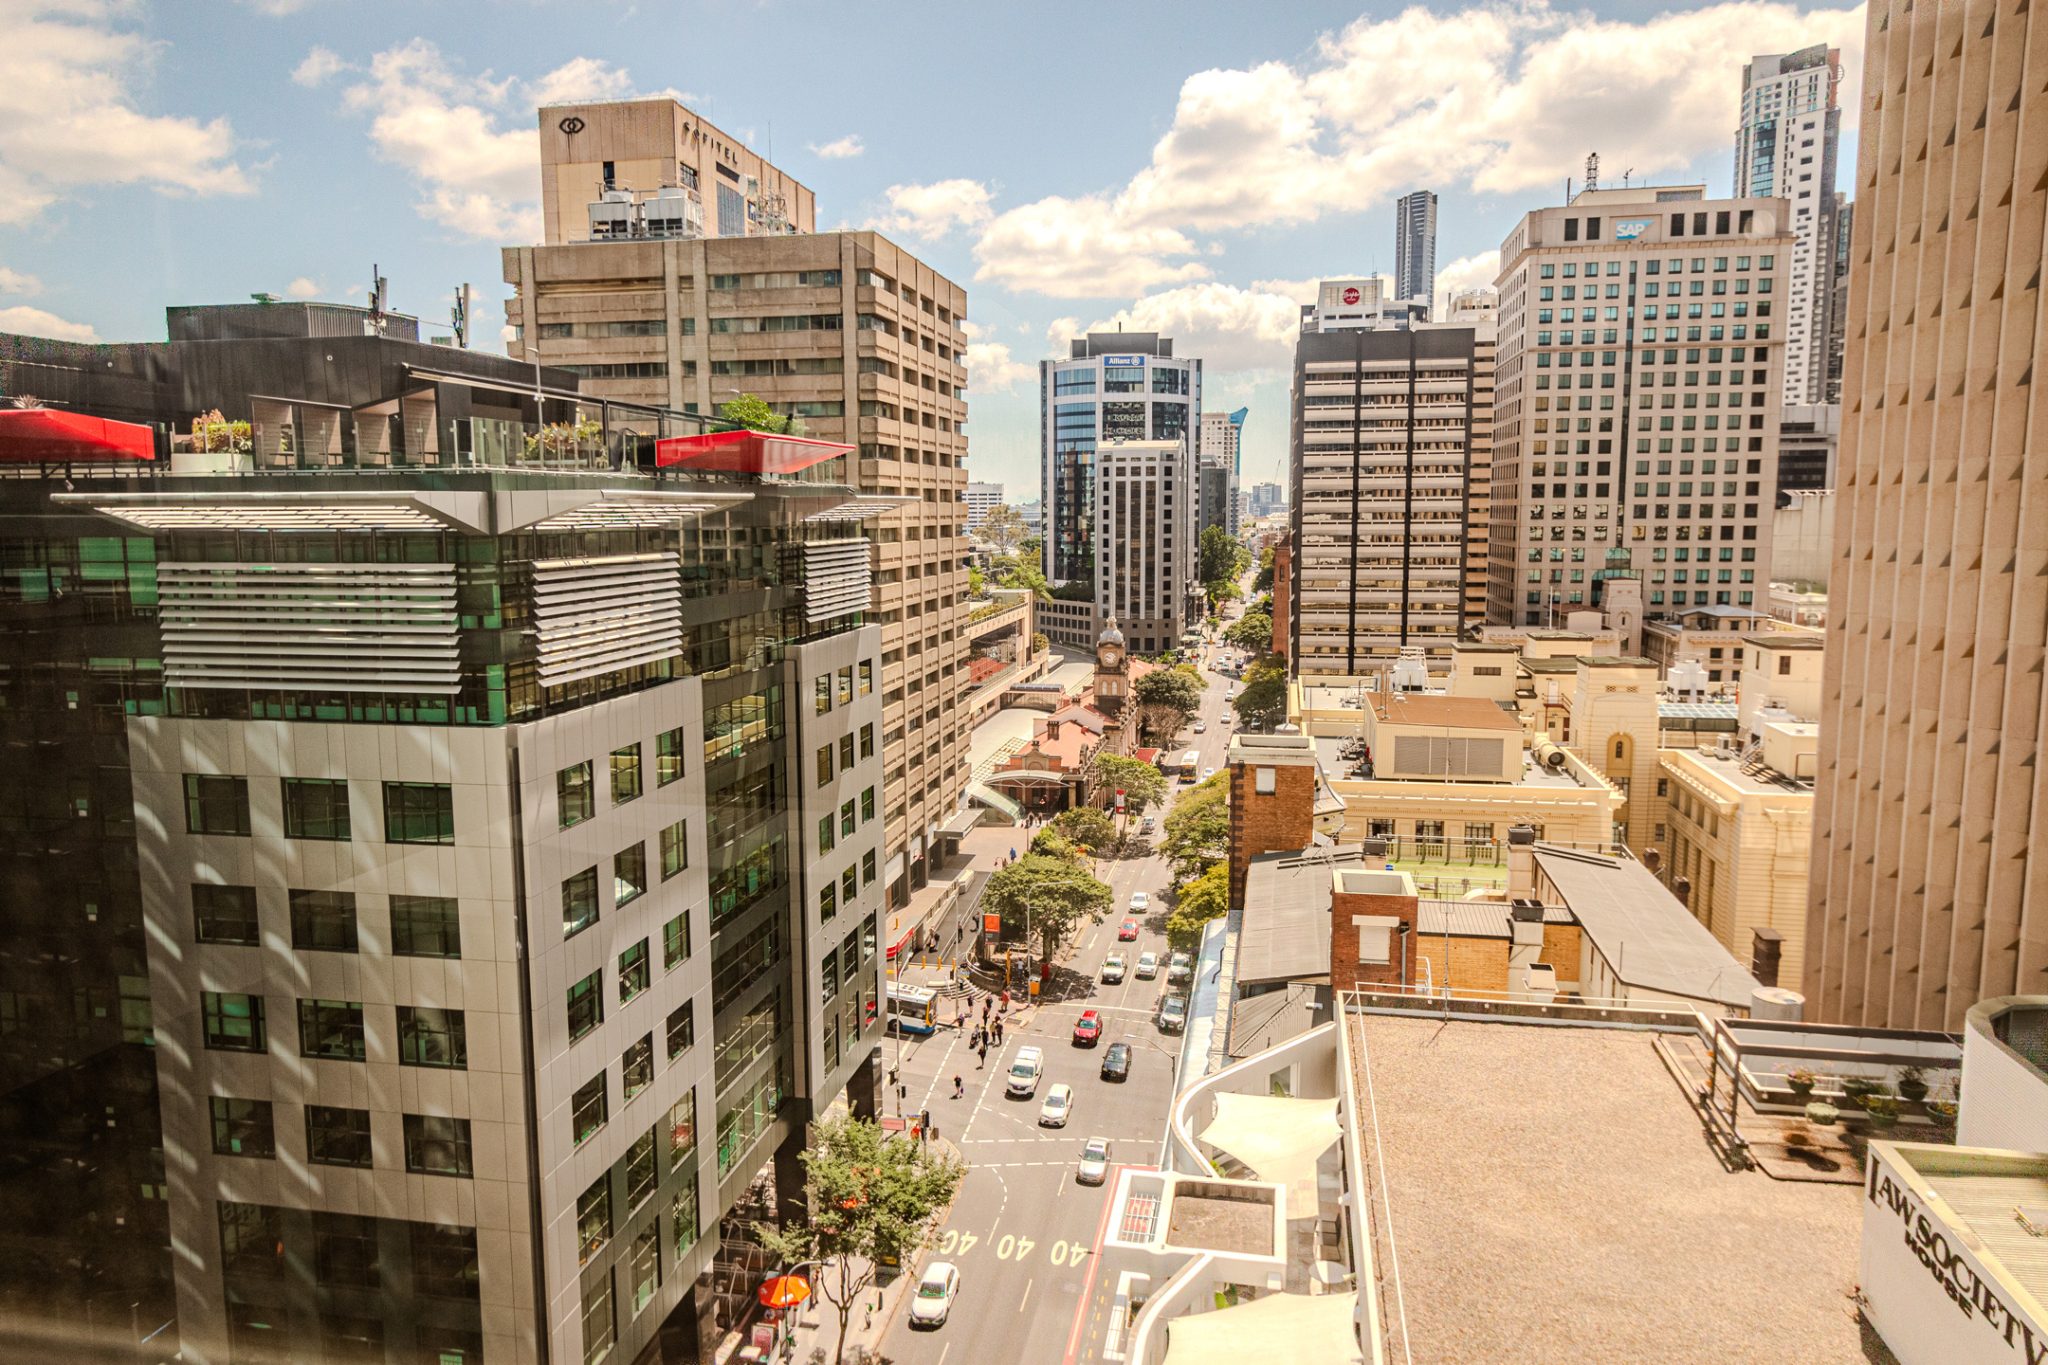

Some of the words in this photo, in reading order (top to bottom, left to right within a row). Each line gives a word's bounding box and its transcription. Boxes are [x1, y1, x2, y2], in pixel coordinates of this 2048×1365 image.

[683, 121, 737, 165] SOFITEL
[1616, 223, 1646, 237] SAP
[1108, 357, 1131, 365] Allianz
[996, 1234, 1036, 1262] 40
[1050, 1239, 1089, 1268] 40
[1868, 1154, 1917, 1227] LAW
[1915, 1213, 2048, 1365] SOCIETY
[1904, 1230, 1973, 1320] HOUSE
